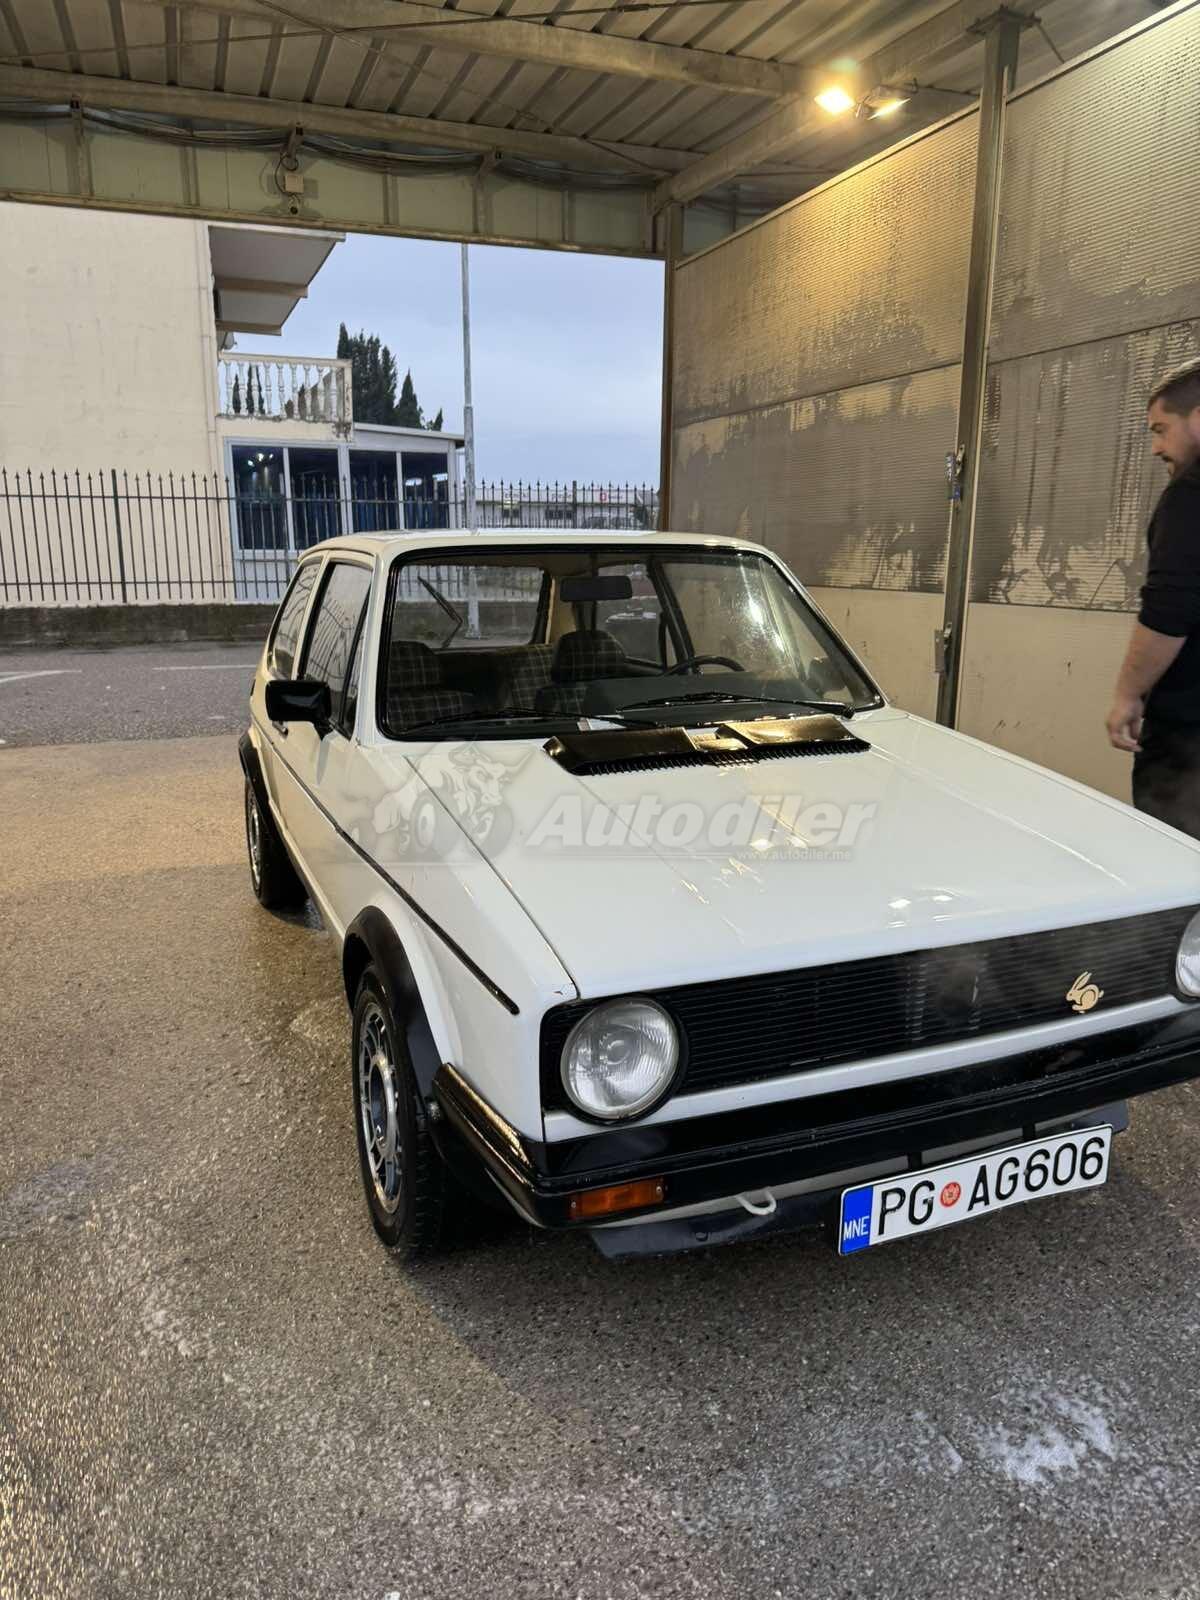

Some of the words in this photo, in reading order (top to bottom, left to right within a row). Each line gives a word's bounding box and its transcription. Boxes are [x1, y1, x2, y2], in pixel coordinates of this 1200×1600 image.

[878, 1180, 935, 1236] PG
[967, 1136, 1105, 1212] AG606
[843, 1215, 870, 1241] MNE
